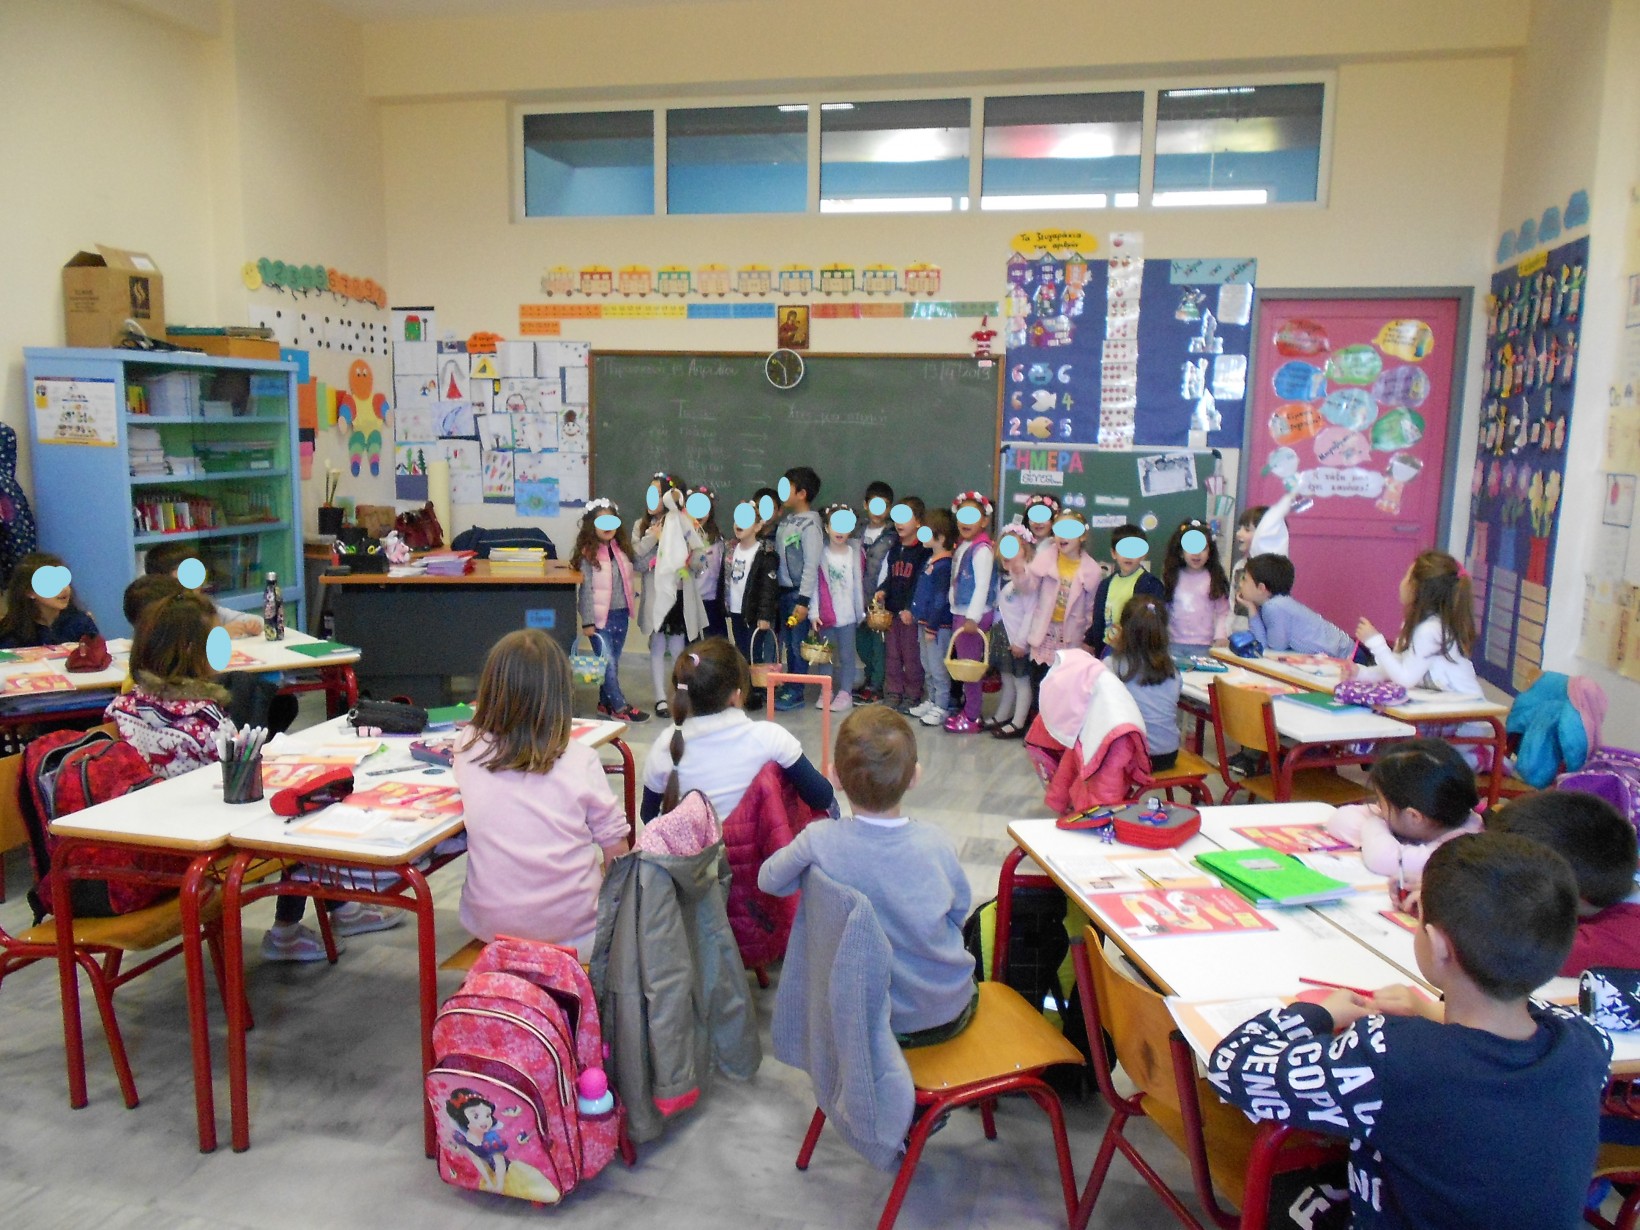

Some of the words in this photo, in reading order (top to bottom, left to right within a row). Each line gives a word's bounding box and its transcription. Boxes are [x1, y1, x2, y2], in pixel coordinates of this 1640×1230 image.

[1011, 363, 1024, 383] 6
[1058, 364, 1072, 384] 6
[1011, 391, 1024, 411] 6
[1062, 391, 1075, 412] 4
[1010, 417, 1022, 437] 2
[1060, 418, 1073, 438] 5
[1005, 447, 1084, 474] ΣΗΜΕΡΑ
[1287, 1042, 1349, 1128] COPY
